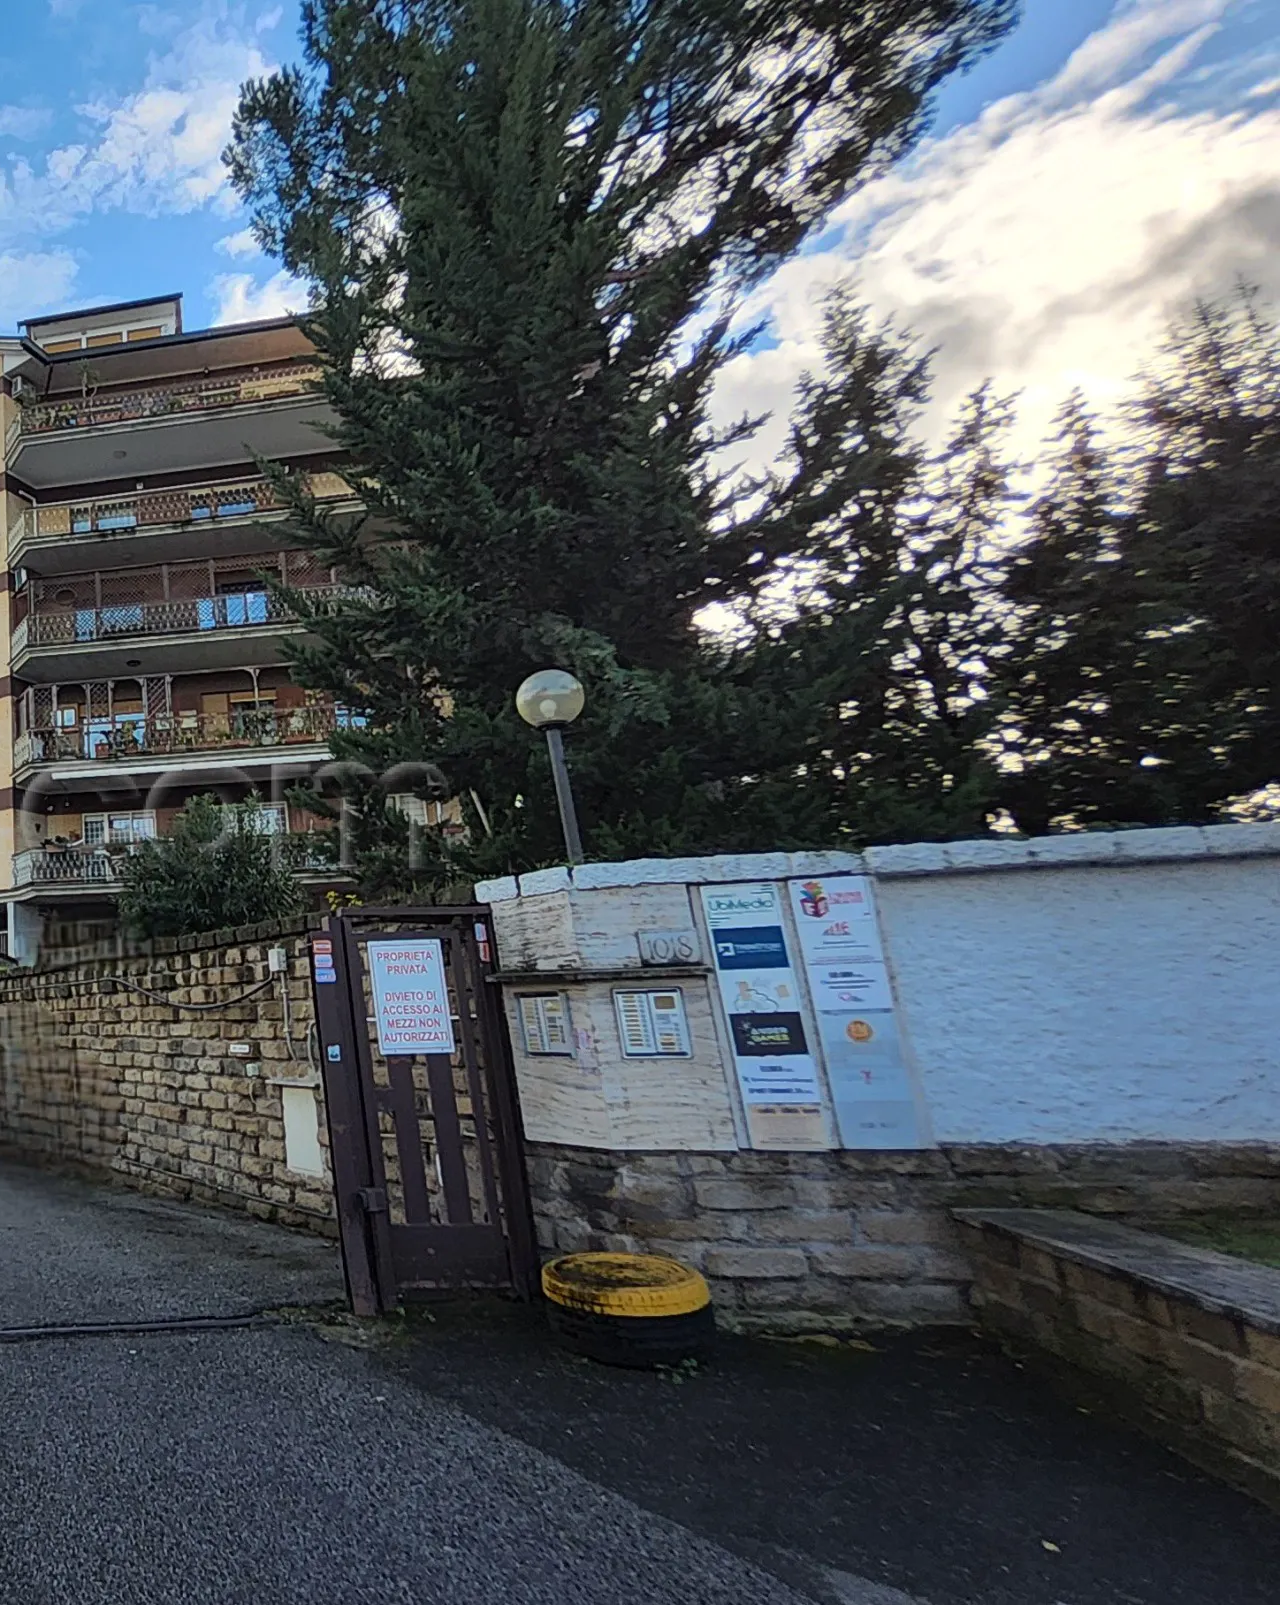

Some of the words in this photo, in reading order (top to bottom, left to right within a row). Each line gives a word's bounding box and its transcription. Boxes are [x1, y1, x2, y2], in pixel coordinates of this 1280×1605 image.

[647, 936, 693, 960] 1018
[386, 964, 428, 975] PRIVATA
[384, 991, 424, 1002] DIVIETO
[426, 990, 437, 1001] DI
[382, 1005, 431, 1016] ACCESSO
[432, 1004, 443, 1014] AI
[387, 1018, 417, 1029] MEZZI
[419, 1018, 441, 1028] NON
[383, 1031, 448, 1043] AUTORIZZATI
